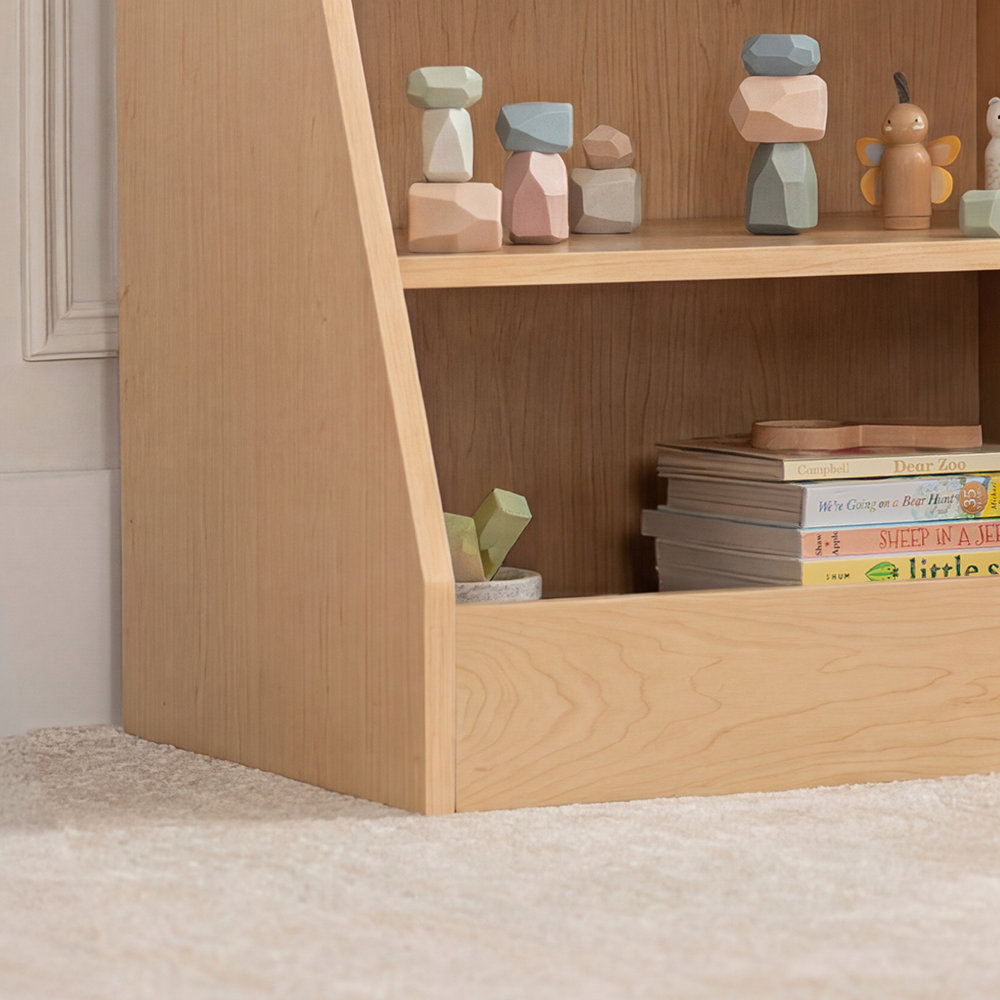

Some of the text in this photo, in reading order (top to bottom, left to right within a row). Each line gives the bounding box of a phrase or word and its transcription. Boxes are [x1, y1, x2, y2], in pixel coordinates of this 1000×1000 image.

[797, 457, 967, 477] Campbell Dear Zoo
[818, 500, 844, 513] We're
[846, 498, 876, 513] Going
[878, 500, 890, 509] on
[892, 500, 899, 508] a
[902, 495, 926, 507] Bear
[963, 489, 977, 508] 35
[879, 527, 930, 549] SHEEP
[936, 525, 952, 545] IN
[958, 527, 970, 546] A
[910, 554, 979, 579] little
